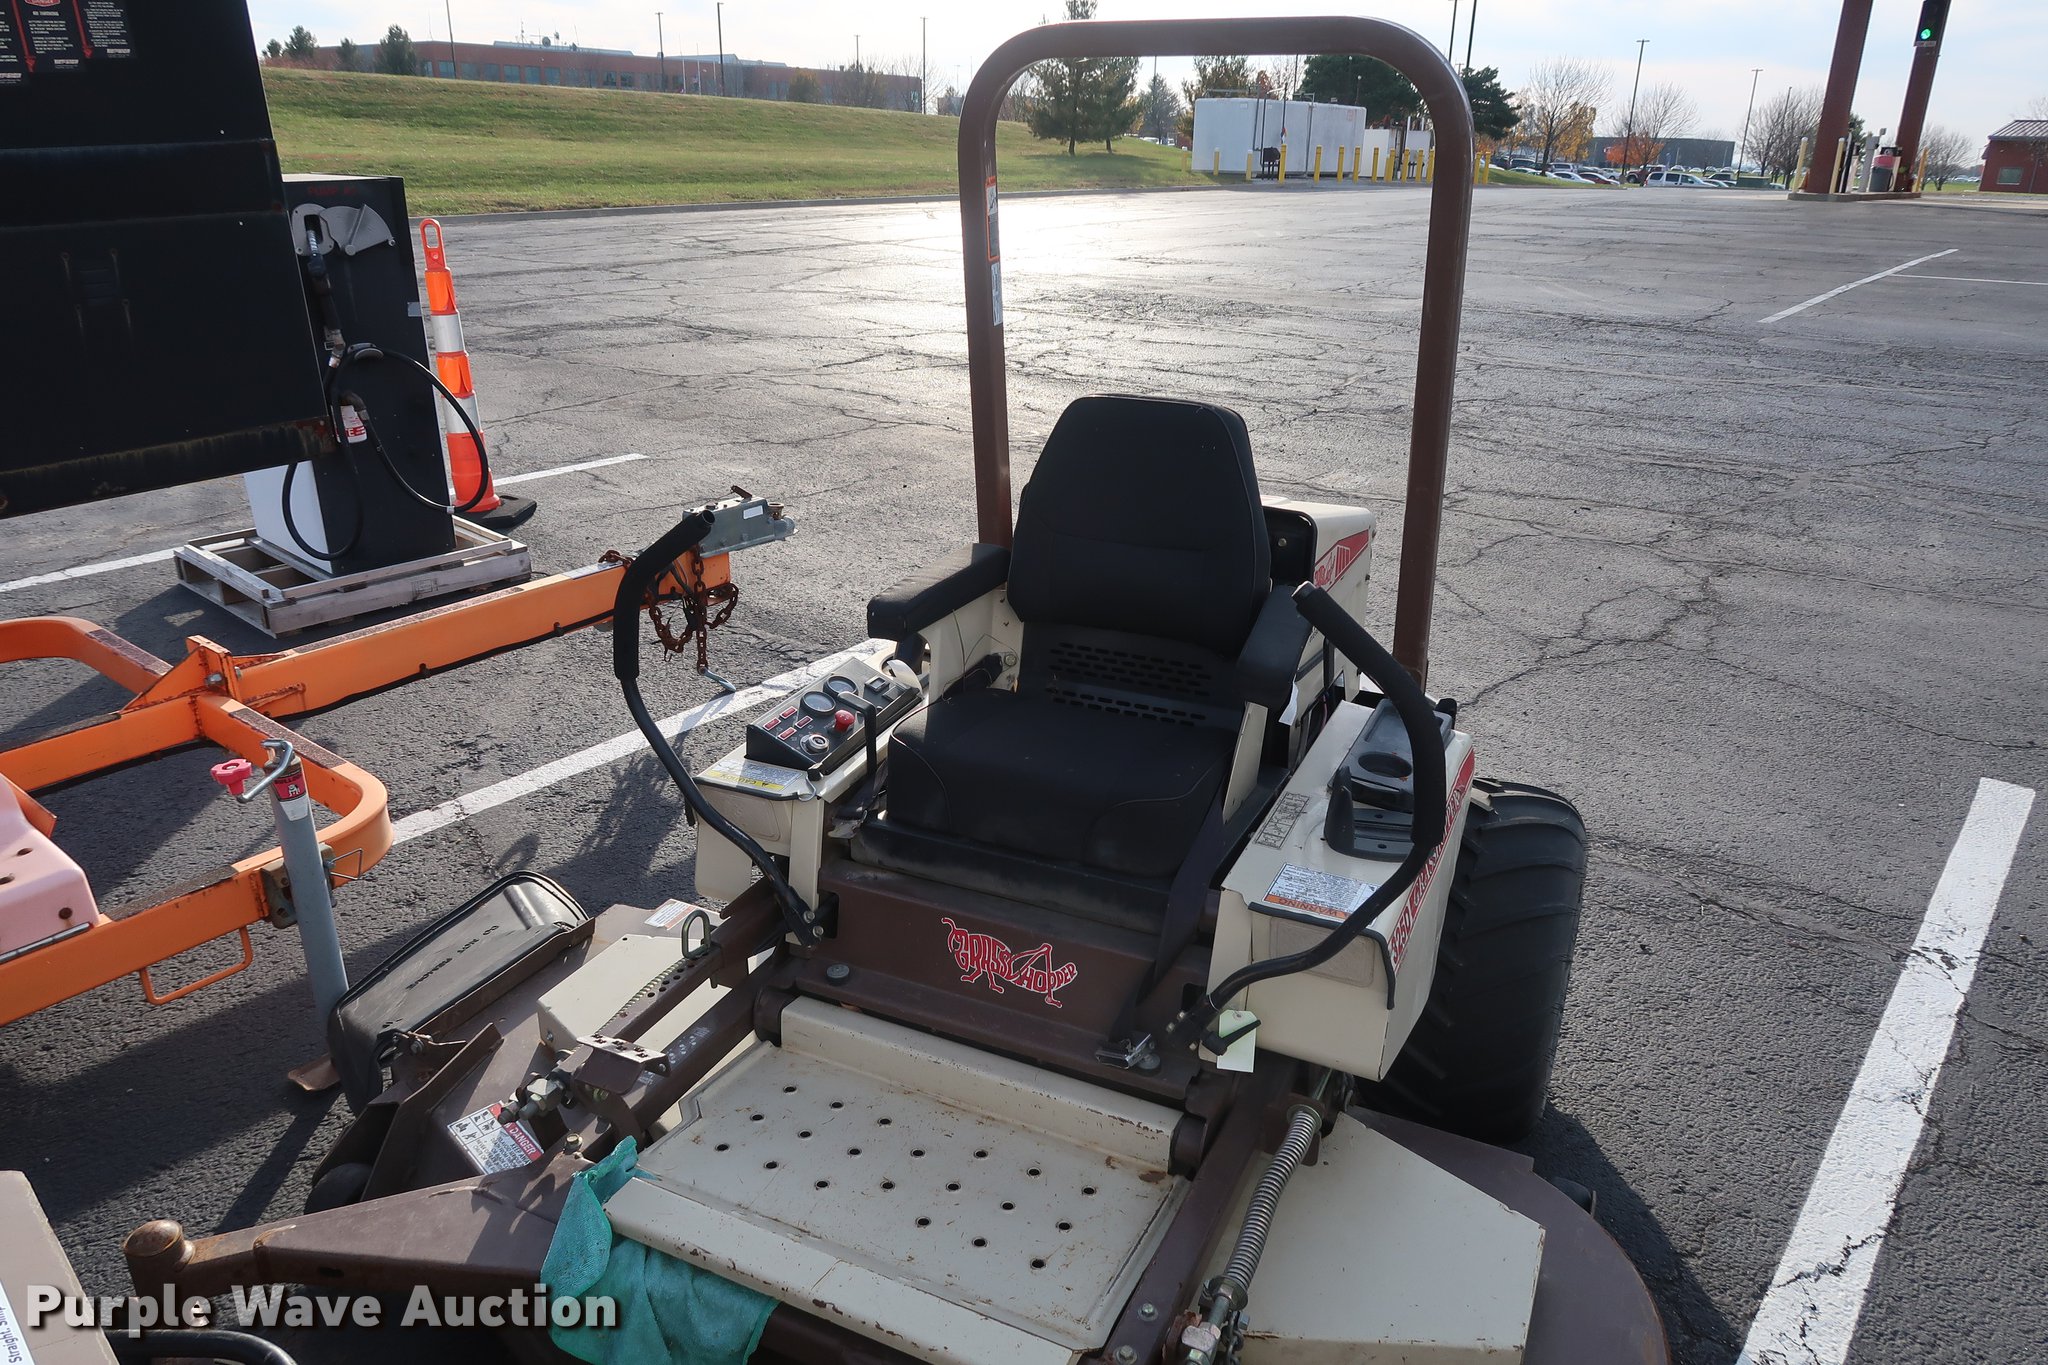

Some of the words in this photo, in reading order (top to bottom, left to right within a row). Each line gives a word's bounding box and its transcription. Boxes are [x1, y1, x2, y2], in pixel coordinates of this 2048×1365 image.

[1277, 898, 1336, 915] WARNING
[948, 928, 1078, 994] GRASSHOPPER
[510, 1127, 536, 1155] DANGER
